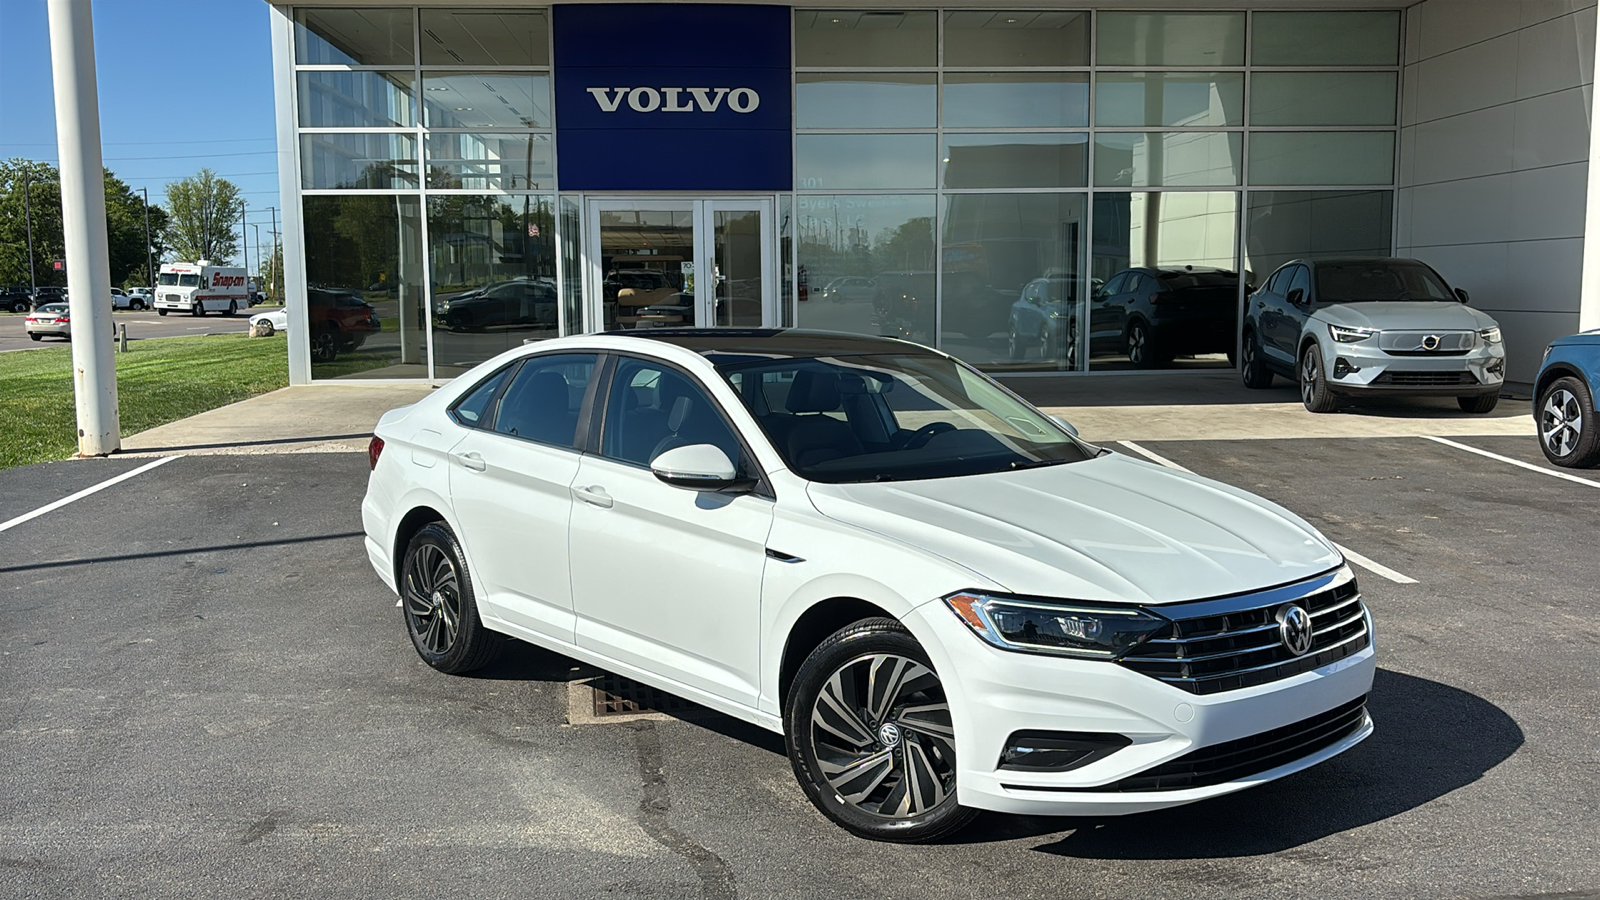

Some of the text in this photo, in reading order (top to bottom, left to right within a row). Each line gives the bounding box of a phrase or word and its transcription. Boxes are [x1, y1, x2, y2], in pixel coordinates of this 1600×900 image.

[586, 87, 760, 113] VOLVO
[799, 198, 840, 212] Byers
[212, 272, 245, 290] Snap-on
